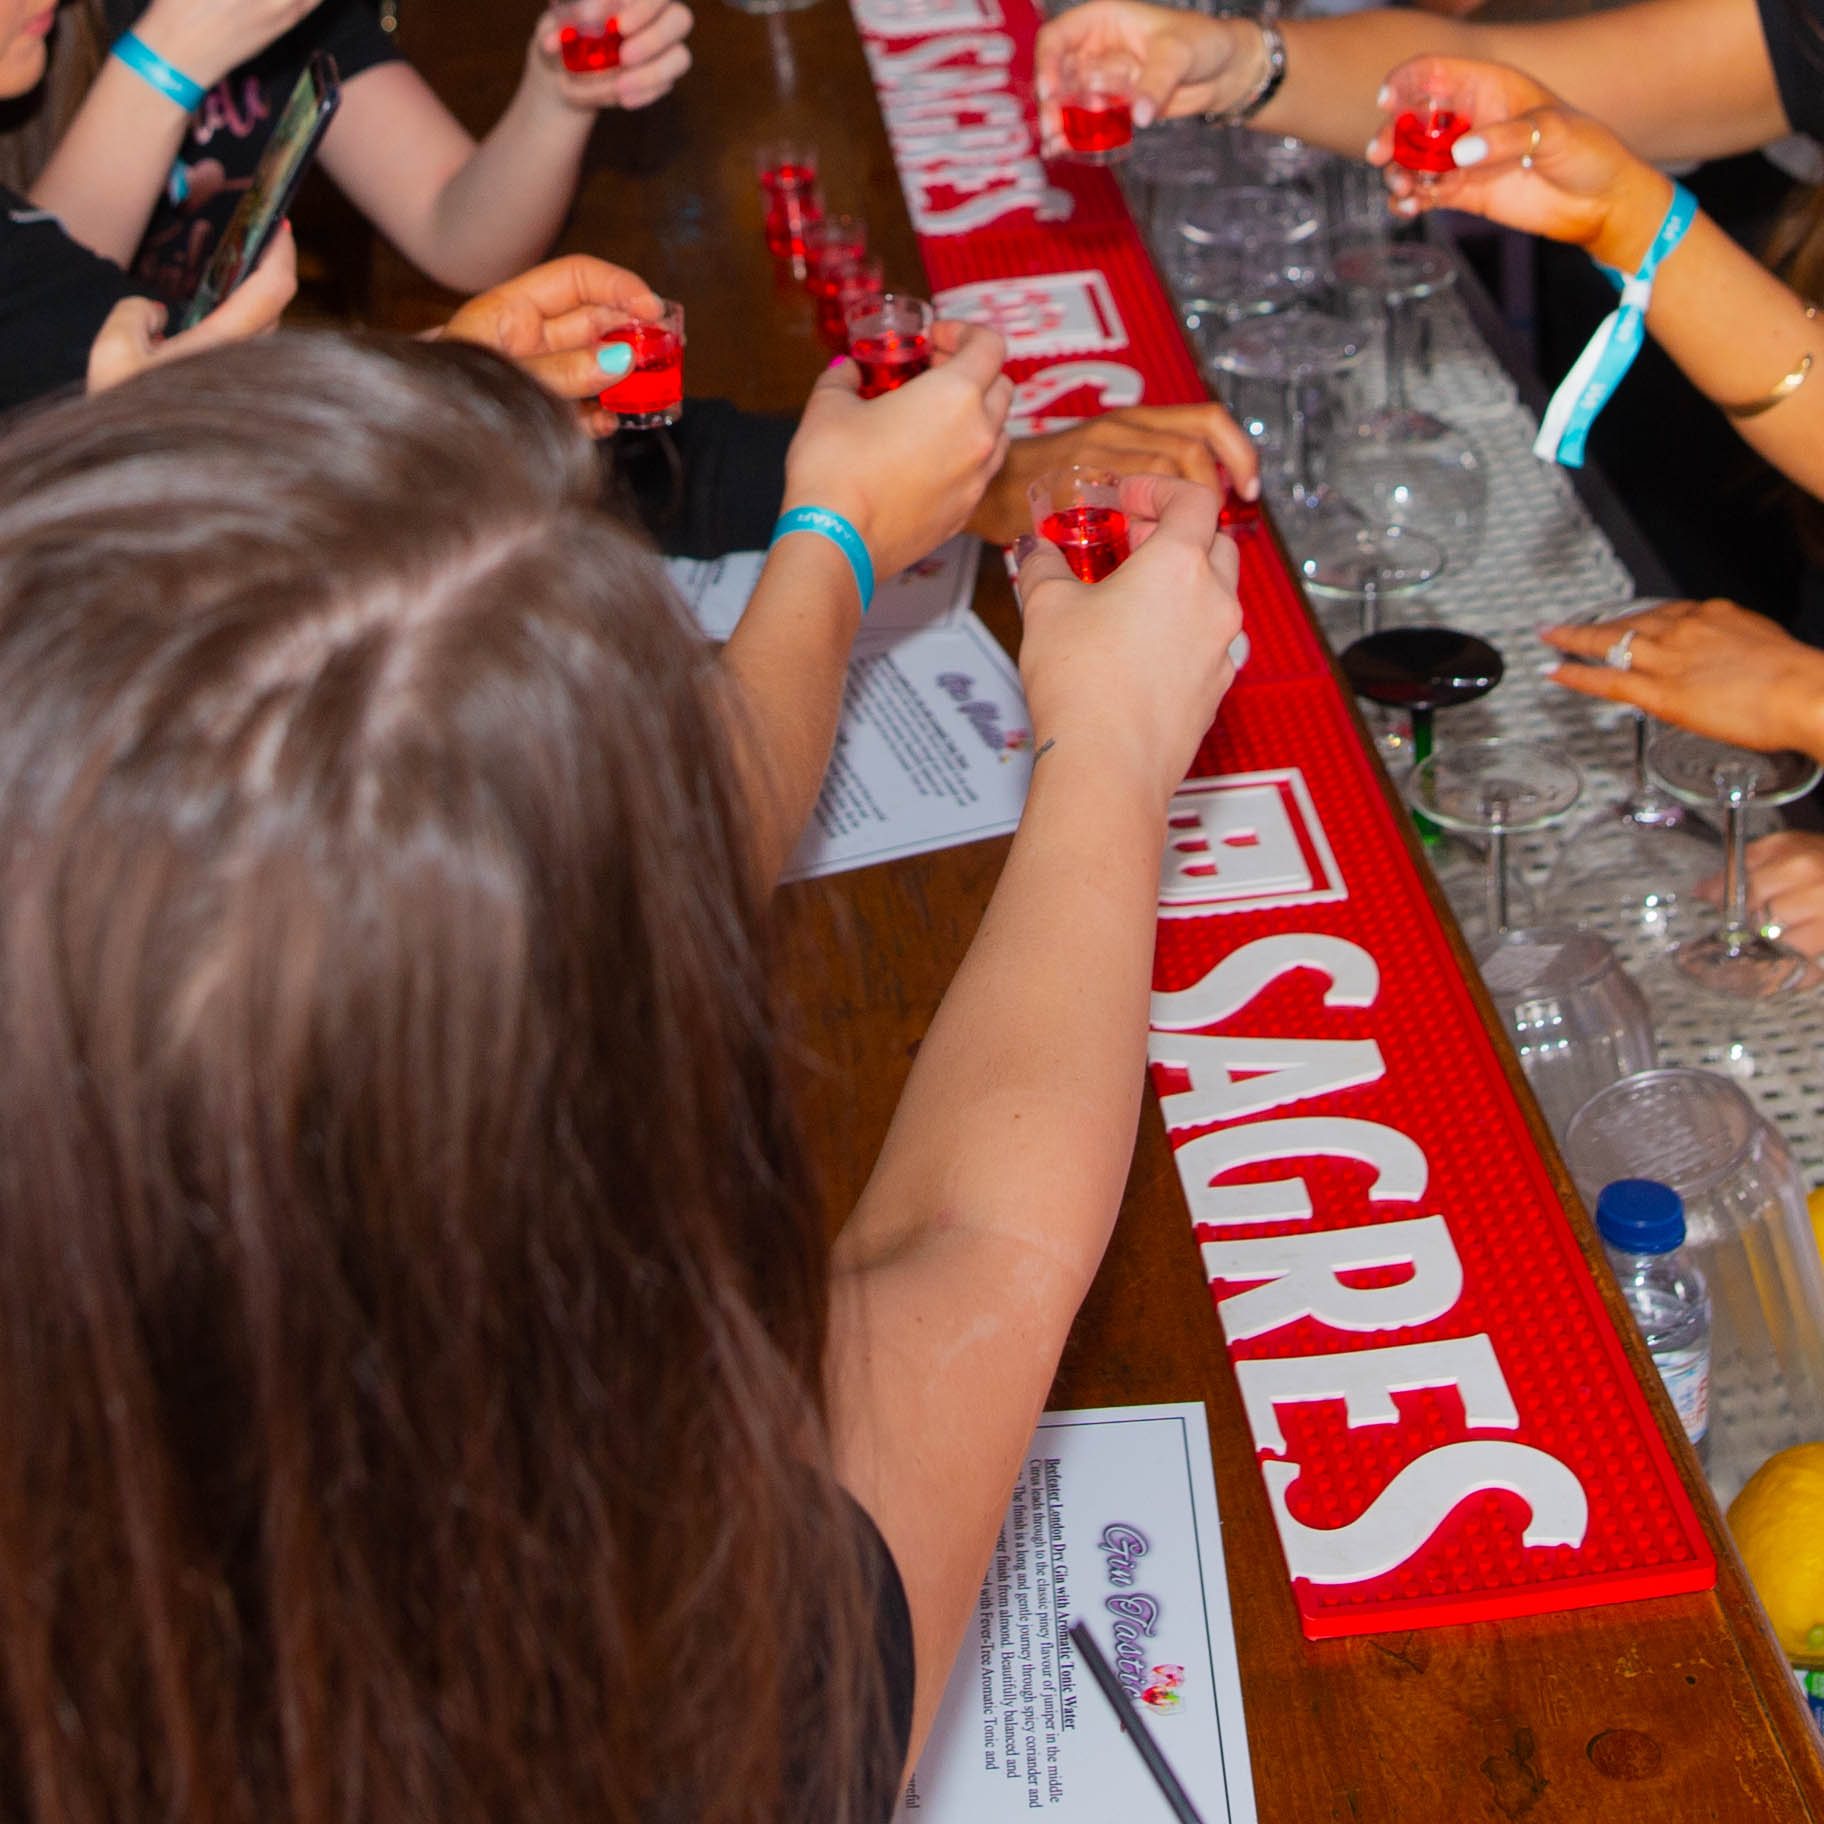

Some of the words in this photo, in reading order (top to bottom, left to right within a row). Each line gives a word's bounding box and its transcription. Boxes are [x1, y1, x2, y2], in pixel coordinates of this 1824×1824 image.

[864, 31, 1076, 237] SAGRES
[1149, 930, 1590, 1586] SAGRES
[1030, 1458, 1044, 1486] Citrus
[1045, 1458, 1063, 1502] Beefeater
[1013, 1485, 1027, 1502] The
[1032, 1488, 1045, 1511] leads
[1014, 1504, 1029, 1530] finish
[1031, 1513, 1047, 1547] through
[1048, 1503, 1064, 1541] London
[1015, 1532, 1029, 1541] is
[1011, 1550, 1029, 1571] long
[1035, 1550, 1048, 1559] to
[1050, 1544, 1067, 1562] Dry
[1098, 1524, 1149, 1587] Gin
[997, 1555, 1011, 1582] finish
[1017, 1573, 1032, 1590] and
[1036, 1562, 1050, 1577] the
[1054, 1565, 1069, 1584] Gin
[980, 1588, 994, 1609] with
[998, 1584, 1012, 1607] from
[1015, 1592, 1033, 1622] gentle
[1037, 1578, 1052, 1609] classic
[1055, 1586, 1071, 1609] with
[980, 1612, 996, 1666] Fever-Tree
[999, 1609, 1015, 1649] almond.
[1017, 1624, 1034, 1661] journey
[1058, 1612, 1075, 1659] Aromatic
[1040, 1642, 1055, 1677] flavour
[1105, 1593, 1162, 1699] Tastic
[981, 1667, 997, 1715] Aromatic
[1000, 1651, 1017, 1707] Beautifully
[1019, 1664, 1038, 1703] through
[1042, 1680, 1057, 1692] of
[1060, 1662, 1076, 1693] Tonic
[1021, 1705, 1039, 1733] spicy
[1041, 1693, 1058, 1730] juniper
[1063, 1695, 1078, 1730] Water
[983, 1717, 999, 1748] Tonic
[1004, 1710, 1020, 1756] balanced
[1046, 1733, 1060, 1744] in
[985, 1750, 1001, 1771] and
[1006, 1759, 1021, 1779] and
[1026, 1735, 1042, 1786] coriander
[1047, 1746, 1061, 1762] the
[1028, 1788, 1044, 1809] and
[1048, 1765, 1064, 1804] middle
